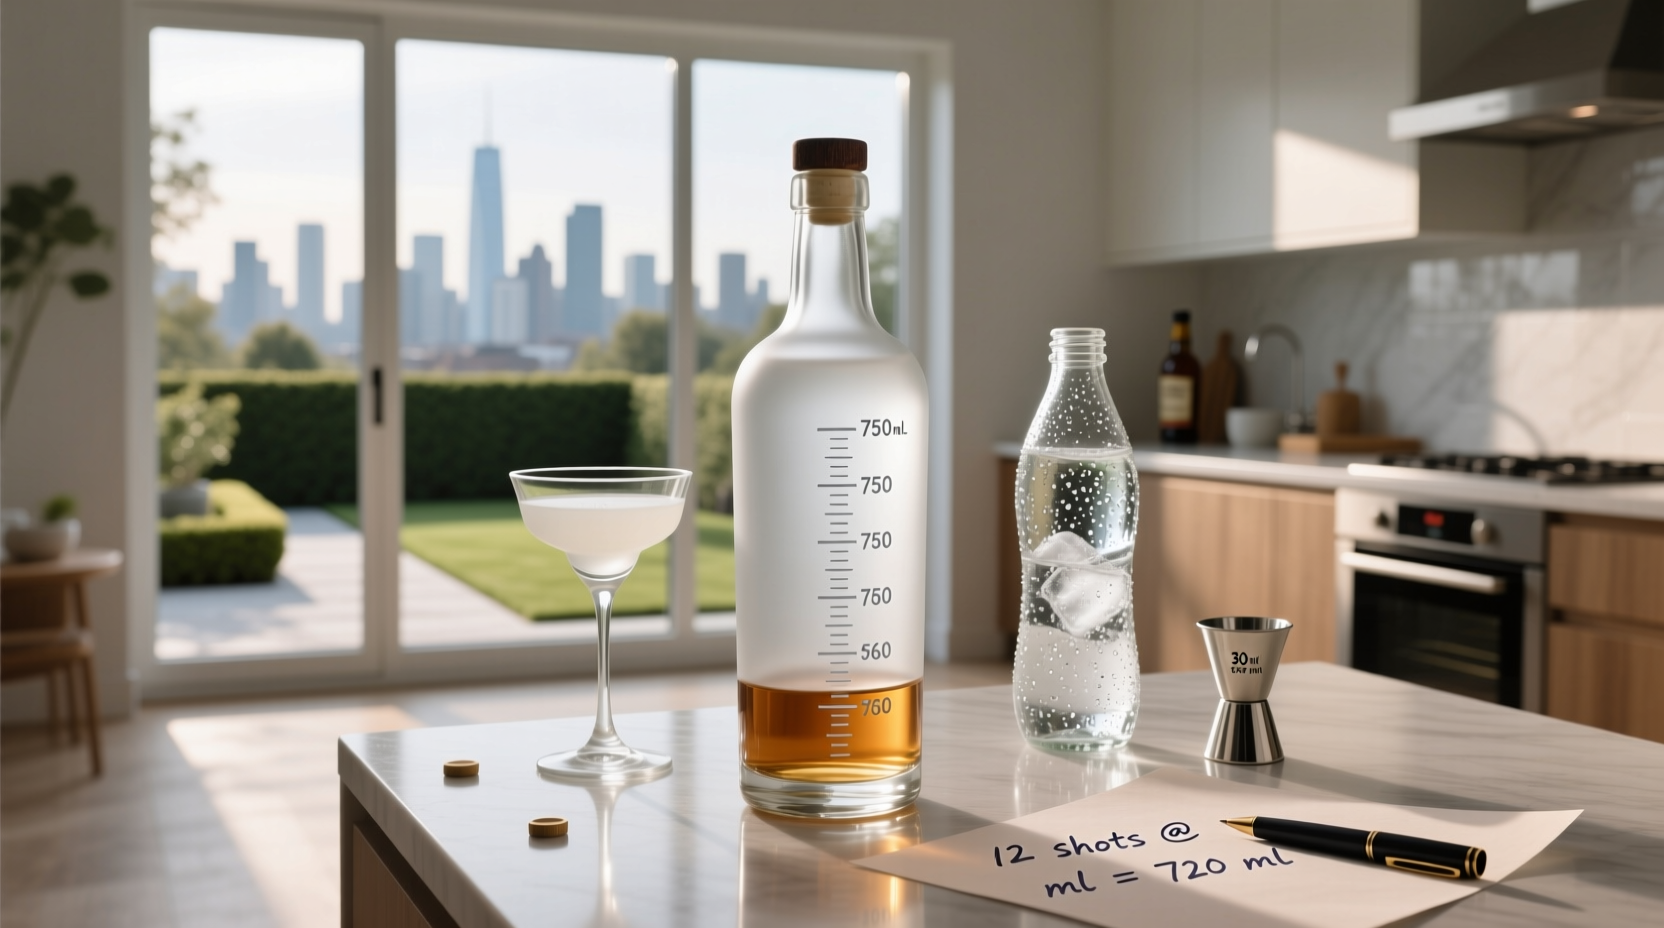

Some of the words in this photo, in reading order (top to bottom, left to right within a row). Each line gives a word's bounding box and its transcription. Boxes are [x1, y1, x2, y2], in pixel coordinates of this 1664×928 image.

[860, 475, 892, 495] 750
[860, 531, 892, 550] 750
[861, 641, 892, 660] 560
[1231, 651, 1248, 665] 30
[994, 844, 1035, 867] 12
[1053, 831, 1146, 858] shots
[1160, 821, 1200, 843] @
[1044, 870, 1097, 898] ml
[1153, 858, 1227, 883] 720
[1242, 847, 1294, 871] ml
